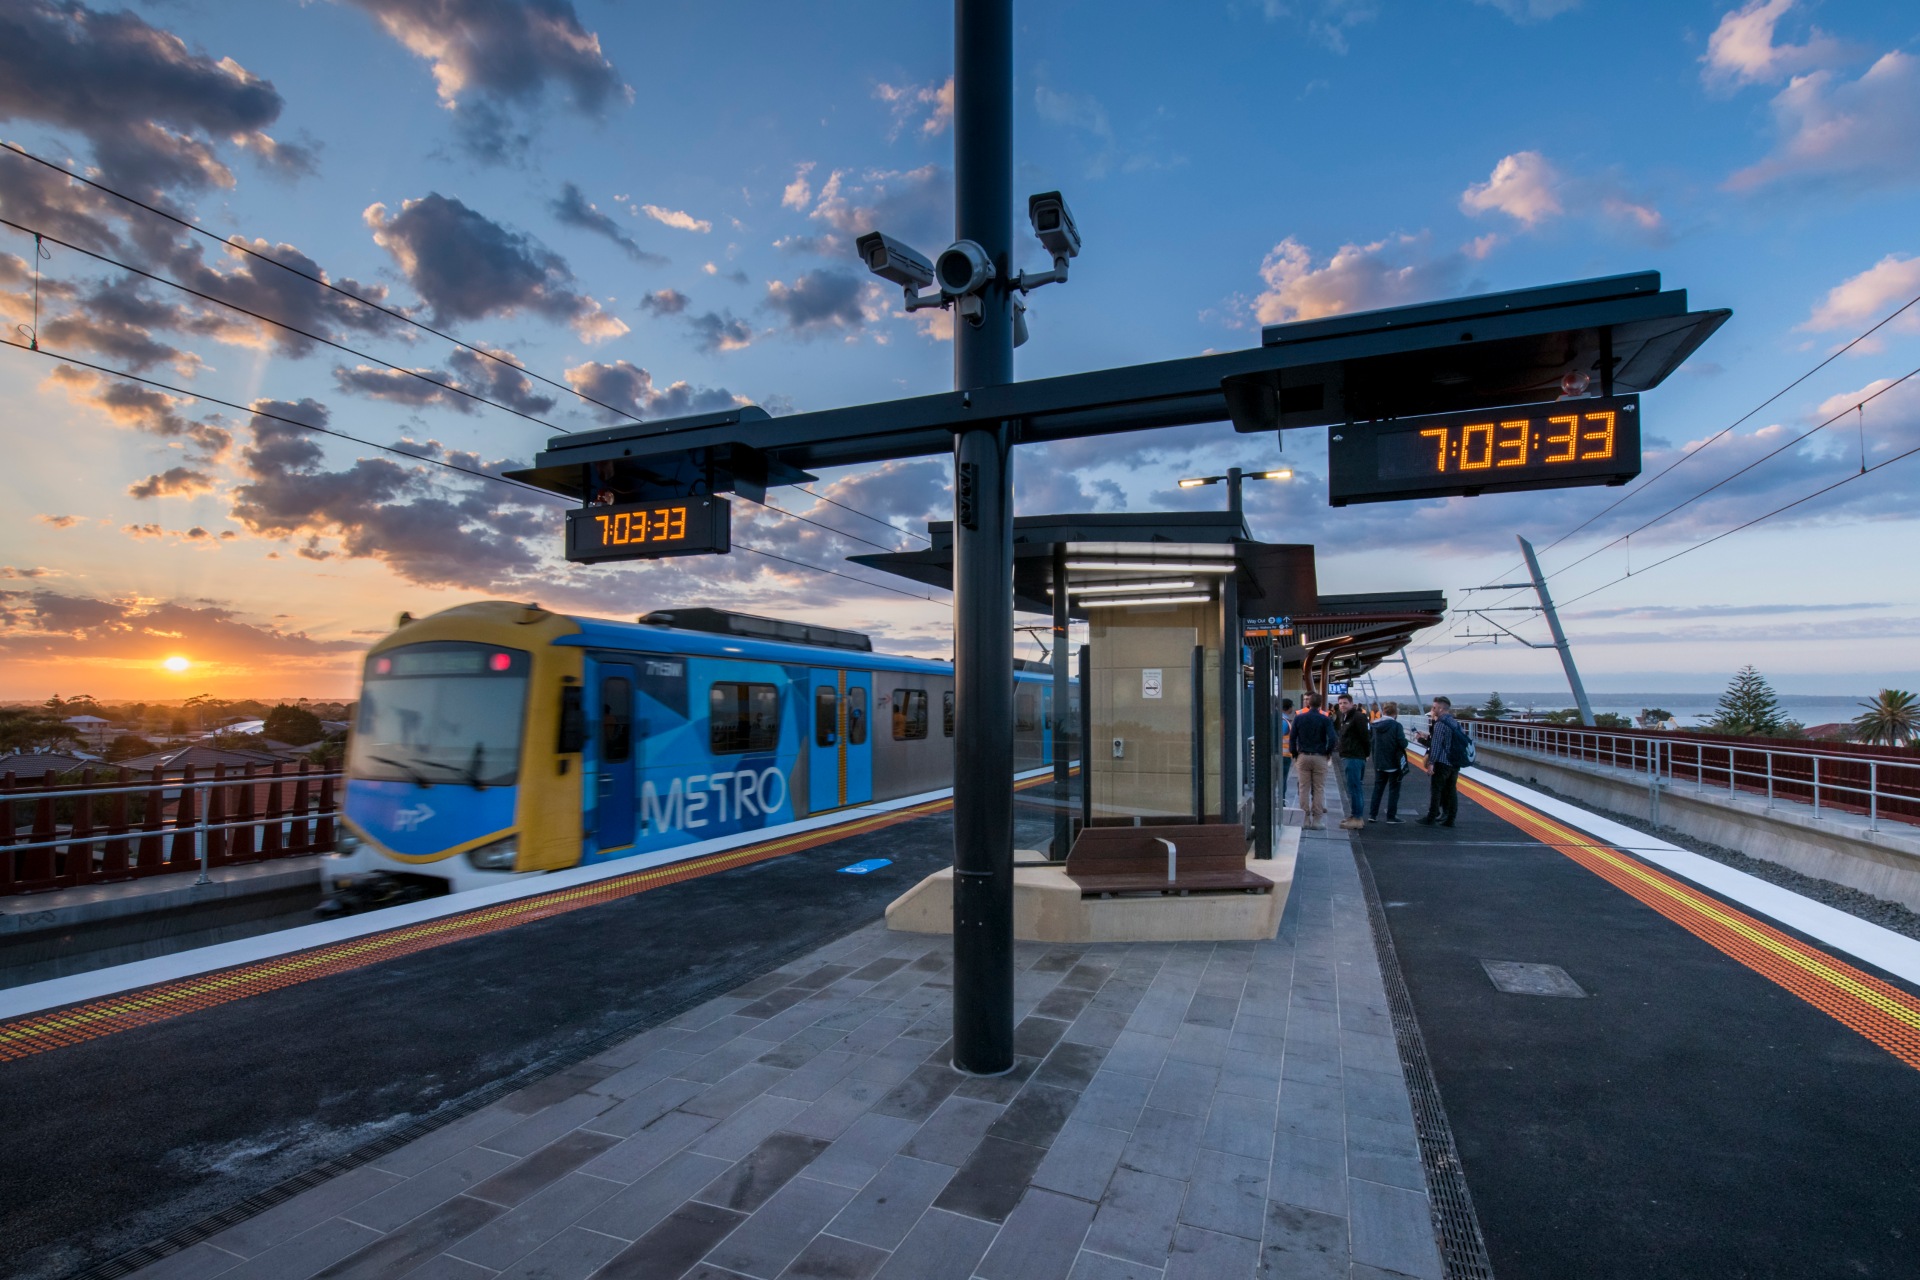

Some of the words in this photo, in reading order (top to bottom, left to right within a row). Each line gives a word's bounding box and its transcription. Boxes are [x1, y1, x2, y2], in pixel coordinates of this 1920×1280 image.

[1420, 411, 1615, 472] 7:03:33
[595, 507, 686, 545] 7:03:33
[641, 767, 786, 836] METRO
